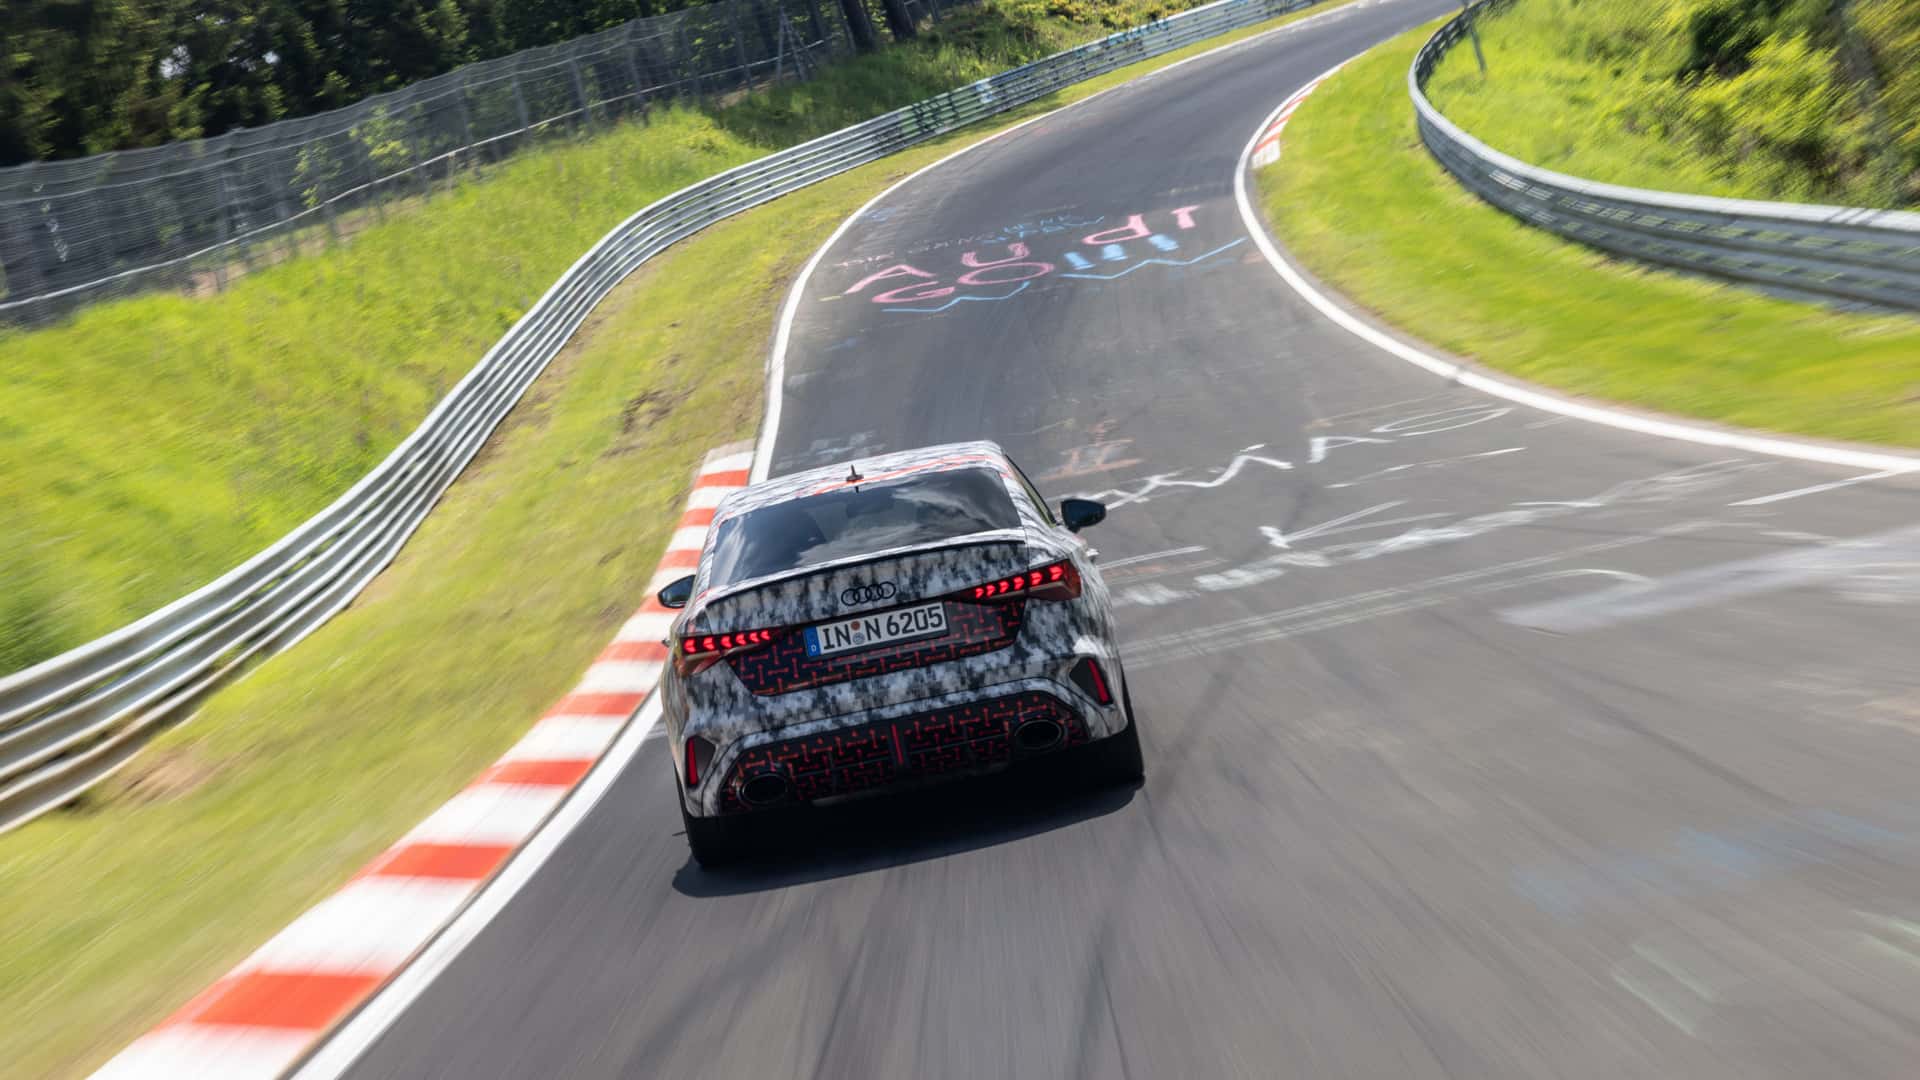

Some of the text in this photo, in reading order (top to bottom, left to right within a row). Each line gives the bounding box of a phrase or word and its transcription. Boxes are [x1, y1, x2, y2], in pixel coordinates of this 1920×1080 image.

[823, 606, 942, 650] IN N 6205
